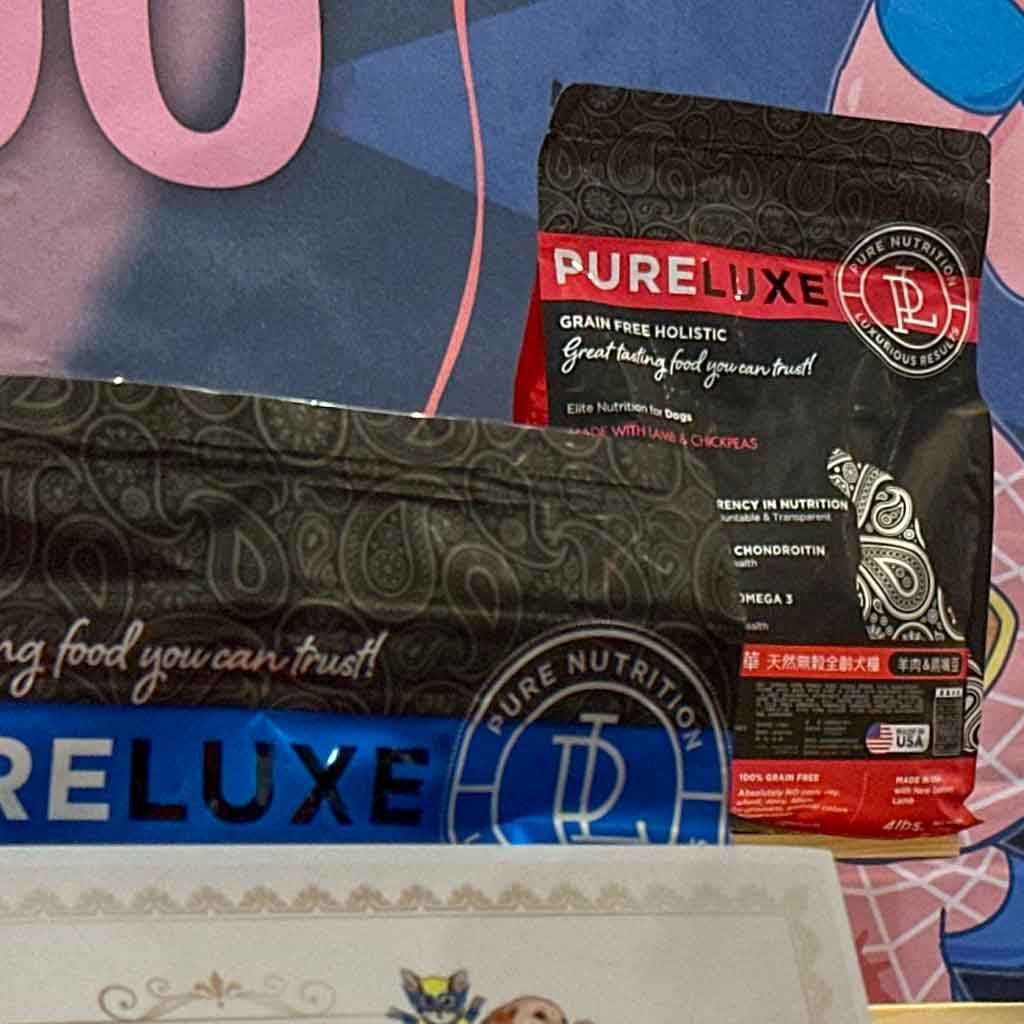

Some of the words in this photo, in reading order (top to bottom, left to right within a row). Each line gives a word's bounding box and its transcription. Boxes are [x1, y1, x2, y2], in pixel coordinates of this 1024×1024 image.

[850, 240, 886, 274] PURE
[890, 235, 958, 288] NUTRITION
[553, 247, 830, 307] PURELUXE
[560, 314, 611, 331] GRAIN
[614, 319, 650, 337] FREE
[655, 325, 728, 342] HOLISTIC
[854, 312, 918, 367] LUXURIOUS
[919, 327, 960, 367] RESULTS
[561, 336, 616, 374] Great
[616, 340, 668, 381] tasting
[669, 348, 708, 376] food
[703, 361, 737, 389] you
[738, 363, 771, 377] can
[771, 352, 818, 378] trust!
[567, 403, 595, 415] Elite
[597, 402, 648, 415] Nutrition
[650, 405, 663, 417] for
[664, 409, 693, 423] Dogs
[611, 424, 646, 438] WITH
[690, 434, 759, 450] CHICKPEAS
[762, 499, 777, 510] IN
[780, 499, 848, 511] NUTRITION
[734, 545, 826, 556] CHONDROITIN
[785, 593, 793, 605] 3
[53, 616, 145, 679] food
[131, 648, 209, 704] you
[210, 648, 289, 673] can
[290, 632, 389, 680] trust!
[486, 664, 558, 736] PURE
[567, 650, 704, 751] NUTRITION
[896, 736, 924, 748] USA
[766, 773, 795, 782] GRAIN
[797, 773, 820, 782] FREE
